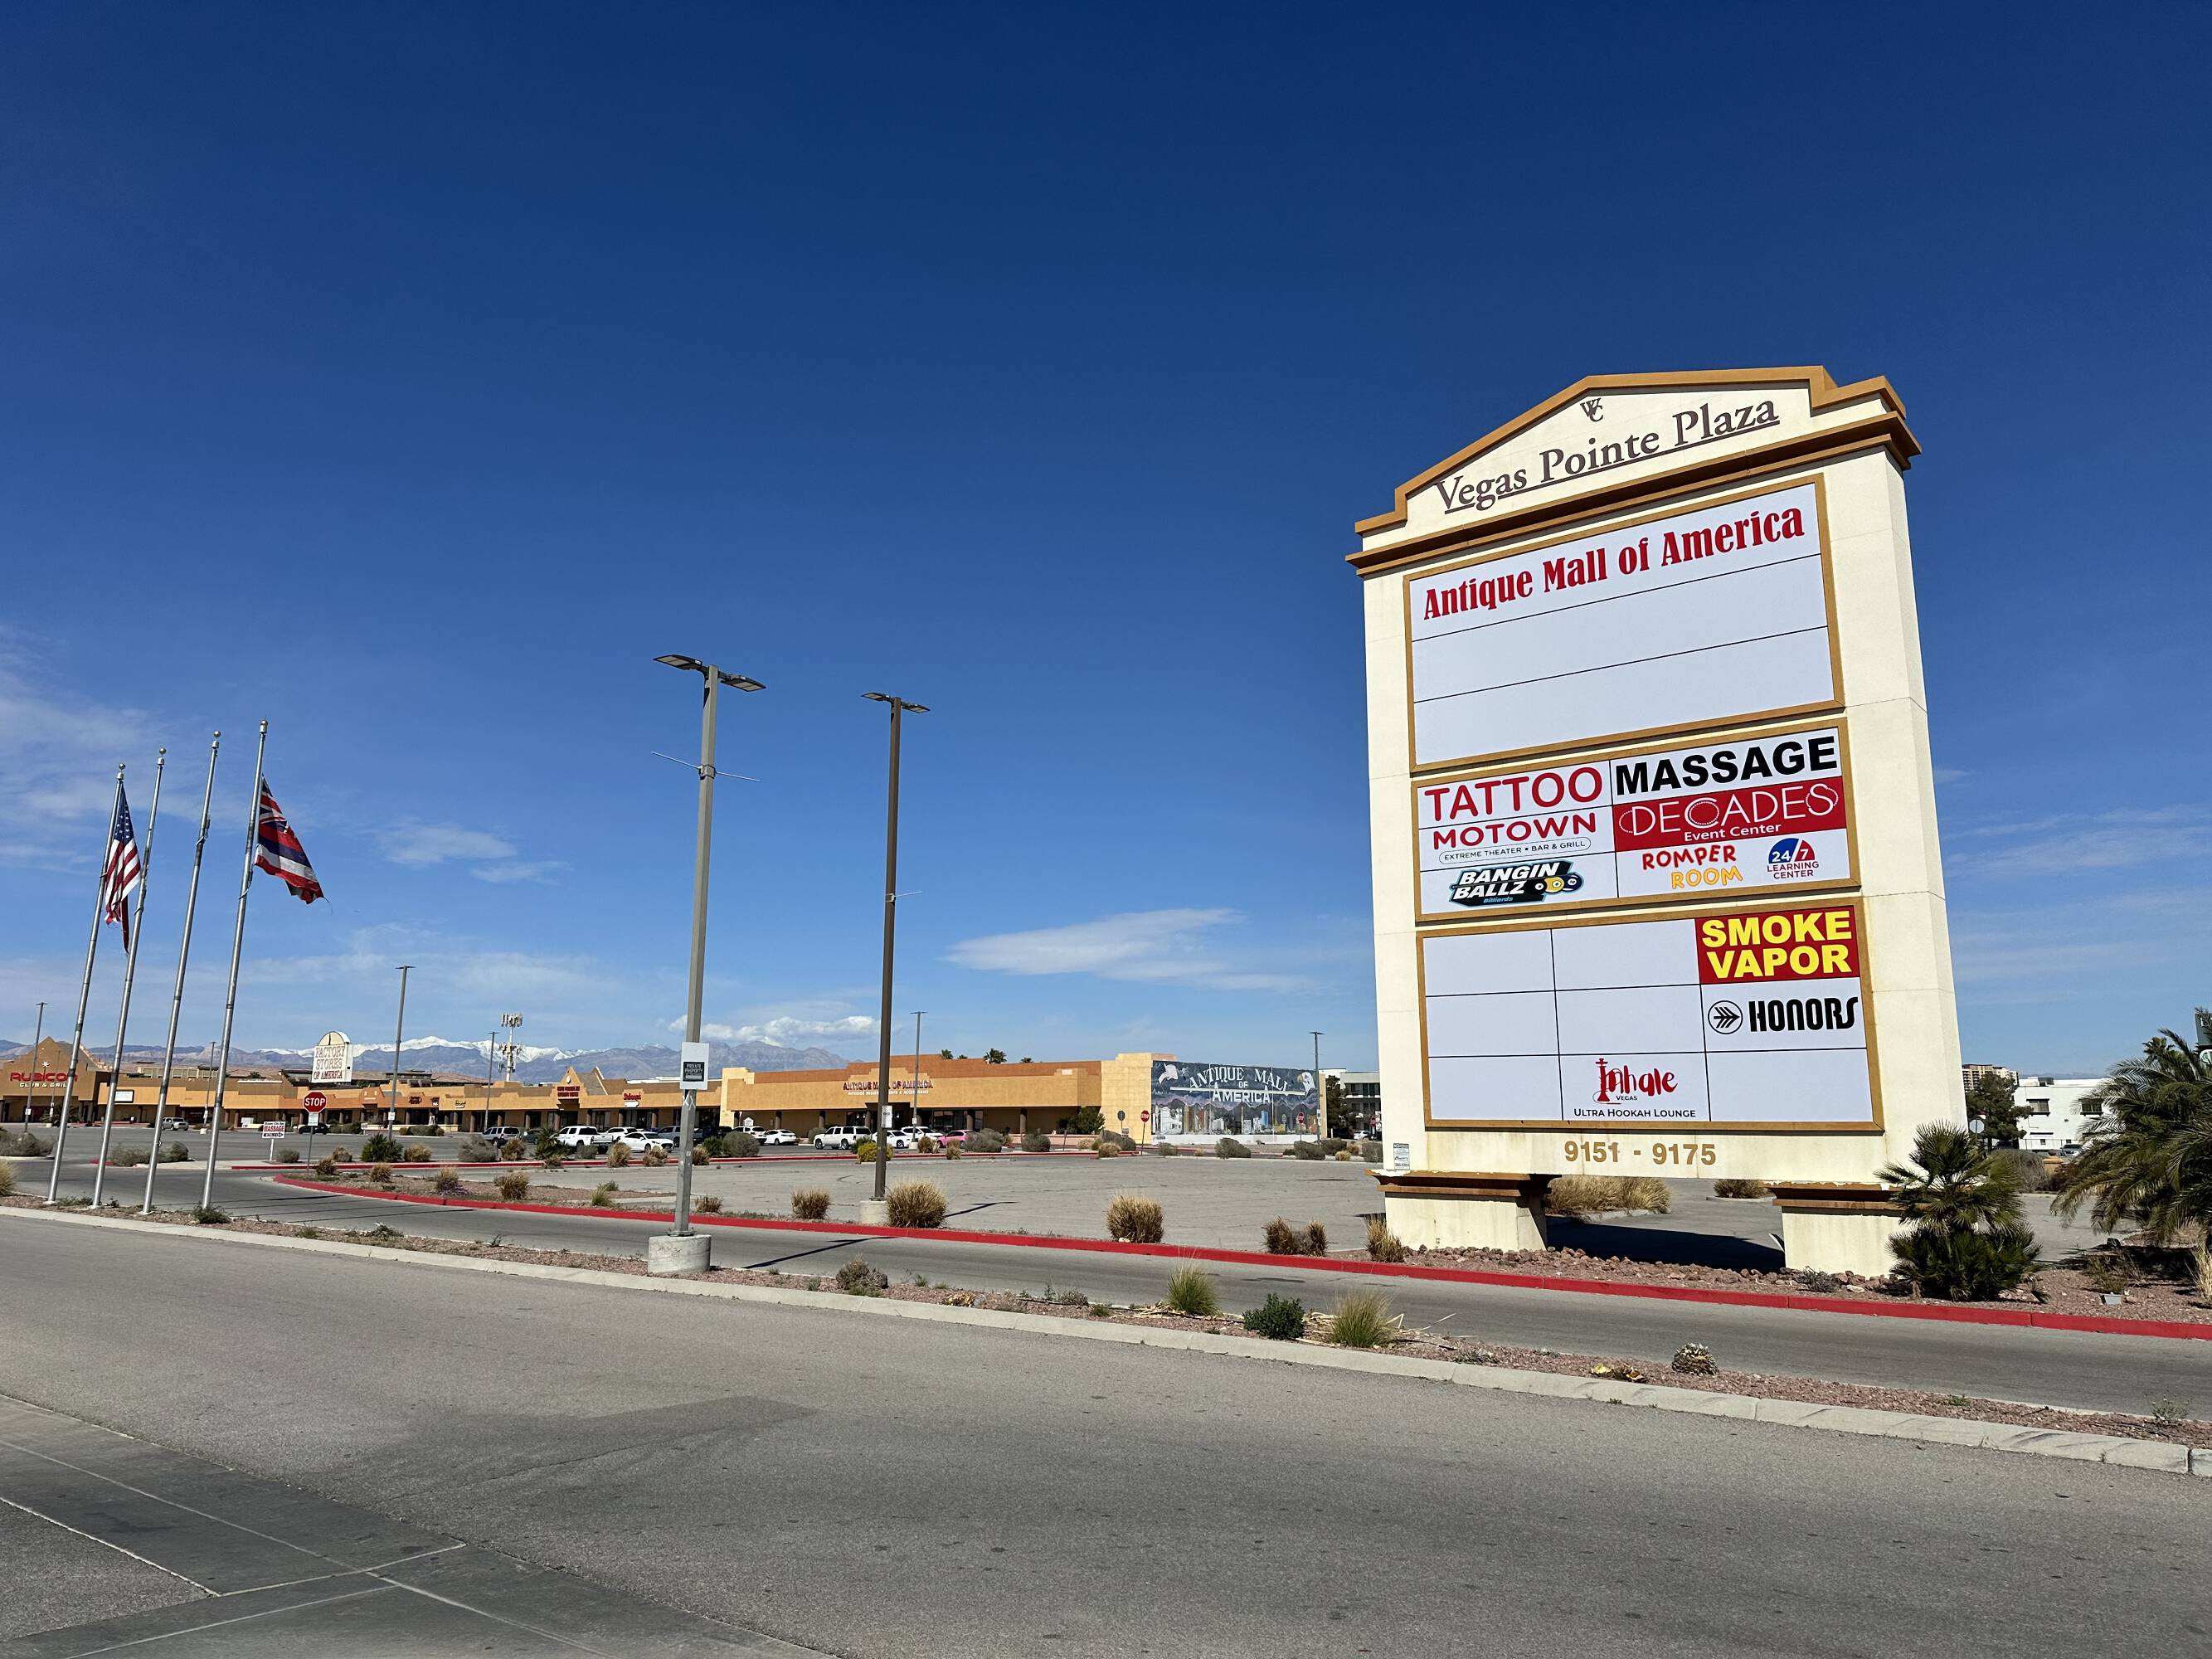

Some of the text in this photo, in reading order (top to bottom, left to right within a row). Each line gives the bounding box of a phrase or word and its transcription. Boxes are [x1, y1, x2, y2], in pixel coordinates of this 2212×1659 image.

[1435, 400, 1780, 511] Vegas Pointe Plaza
[1423, 507, 1805, 620] Antique Mall of America
[1616, 736, 1837, 795] MASSAGE
[1424, 766, 1602, 821] TATTOO
[1619, 783, 1839, 835] DECADES
[1433, 812, 1596, 849] MOTOWN
[1685, 824, 1782, 842] Event Center
[1444, 851, 1482, 860] EXTREME
[1485, 847, 1522, 856] THEATER
[1642, 844, 1737, 869] ROMPER
[1458, 862, 1560, 885] BANGIN
[1671, 866, 1743, 890] ROOM
[1767, 861, 1819, 872] LEARNING
[1773, 869, 1814, 879] CENTER
[1452, 880, 1527, 900] BALLZ
[1702, 911, 1852, 947] SMOKE
[1706, 944, 1852, 979] VAPOR
[1748, 997, 1859, 1032] HONORS
[315, 1046, 345, 1058] FACTORY
[316, 1058, 343, 1069] STORES
[314, 1071, 320, 1079] OF
[1189, 1066, 1245, 1092] ANTIQUE
[304, 1097, 325, 1107] STOP
[1212, 1081, 1271, 1103] AMERICA
[1574, 1108, 1696, 1117] ULTRA HOOKAH LOUNGE
[1564, 1141, 1619, 1162] 9151
[1652, 1143, 1716, 1165] 9175
